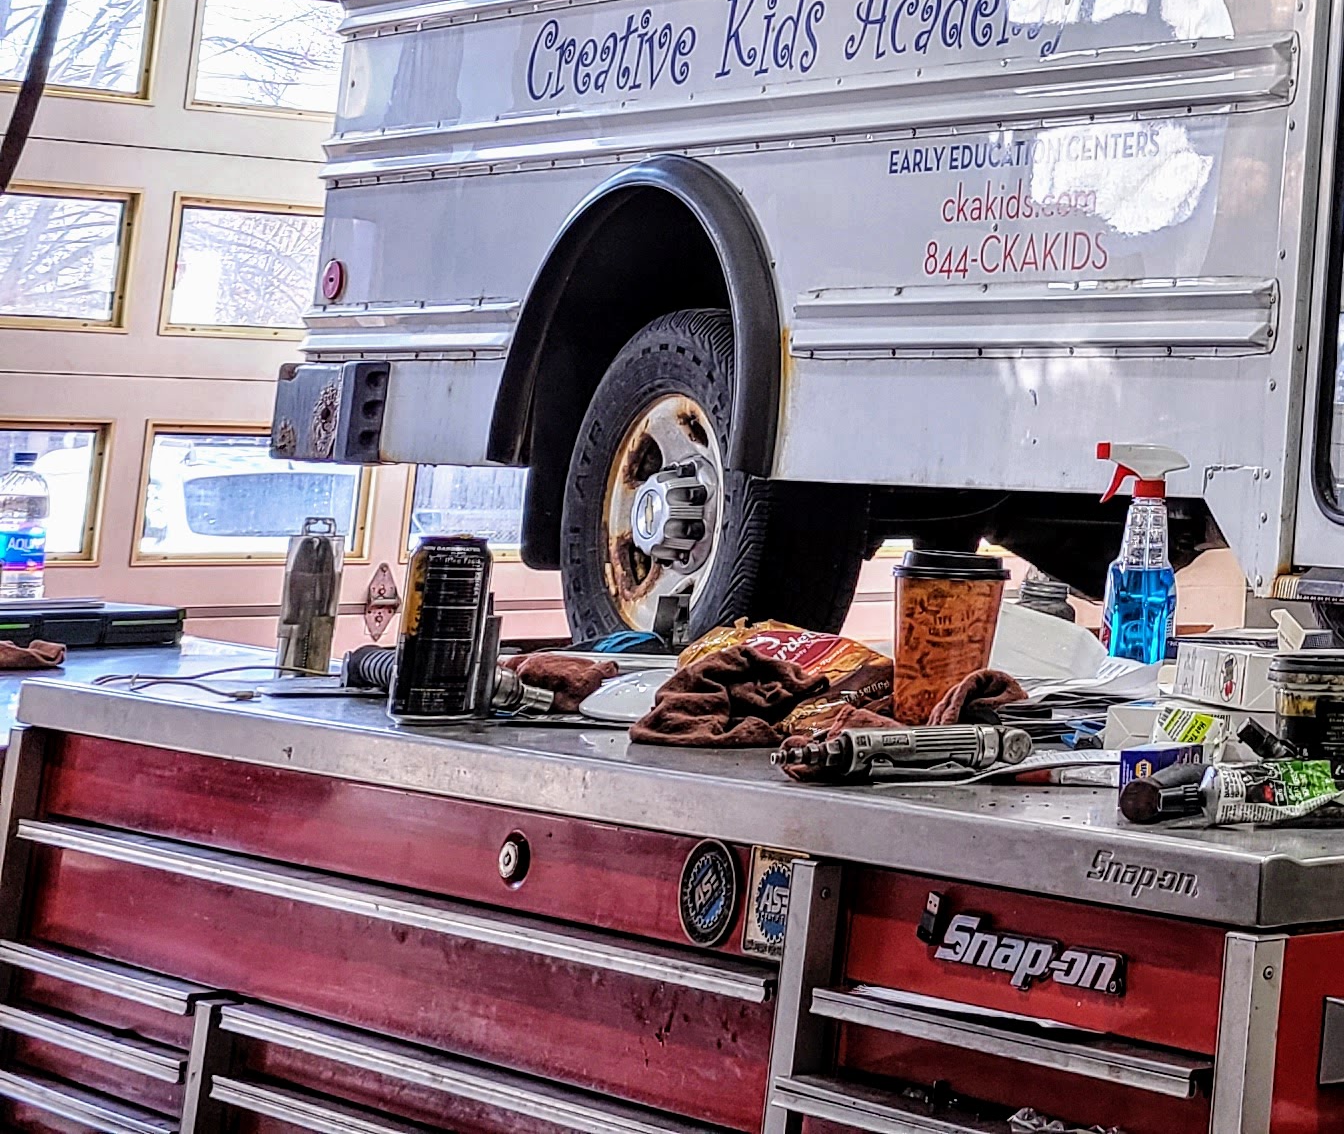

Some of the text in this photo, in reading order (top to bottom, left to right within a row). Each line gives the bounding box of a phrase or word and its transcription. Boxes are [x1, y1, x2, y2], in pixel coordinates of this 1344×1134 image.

[526, 7, 697, 102] Creative
[888, 146, 946, 174] EARLY
[1067, 130, 1160, 163] CENTERS
[942, 179, 1098, 222] ckakids.com
[924, 232, 1108, 280] 844-CKAKIDS
[1087, 850, 1198, 898] Snap-on
[933, 913, 1120, 991] Snap-on
